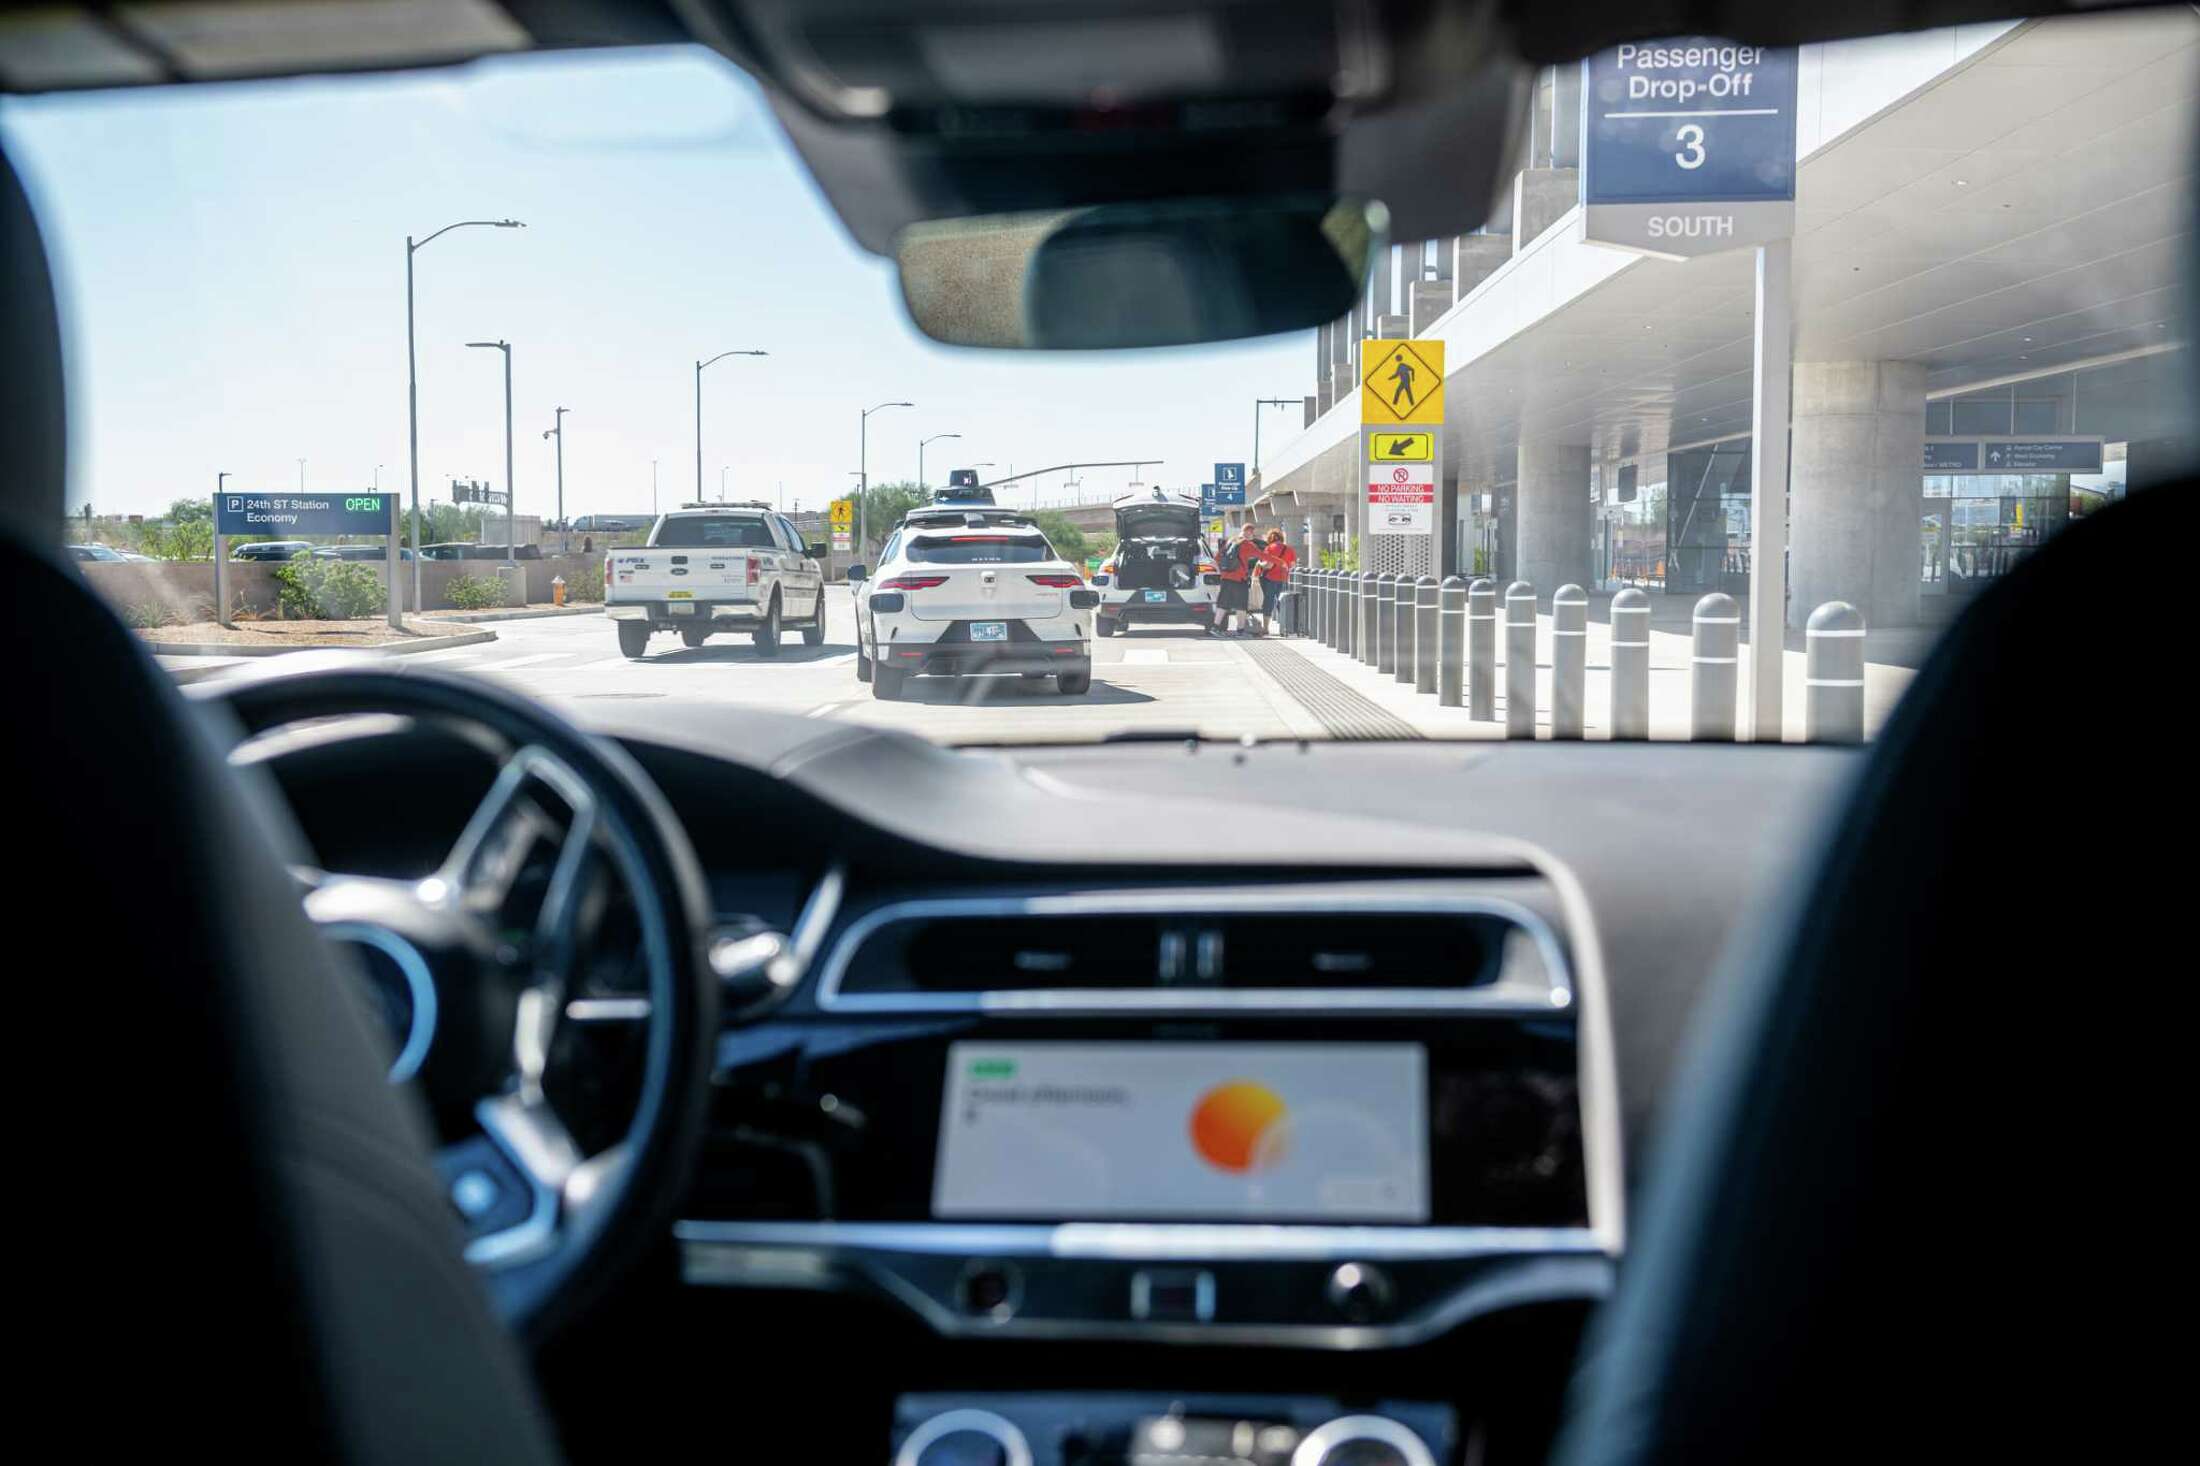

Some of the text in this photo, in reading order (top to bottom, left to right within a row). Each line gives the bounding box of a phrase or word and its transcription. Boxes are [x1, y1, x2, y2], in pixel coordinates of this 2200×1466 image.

[1618, 44, 1764, 73] Passenger
[1629, 73, 1753, 103] Drop-Off
[1675, 124, 1706, 170] 3
[1648, 216, 1734, 237] SOUTH
[1377, 485, 1424, 493] NO PARKING
[247, 500, 271, 510] 24th
[273, 500, 288, 510] ST
[291, 500, 329, 510] Station
[345, 498, 381, 512] OPEN
[1378, 495, 1424, 503] NO WAITING
[247, 513, 297, 524] Economy
